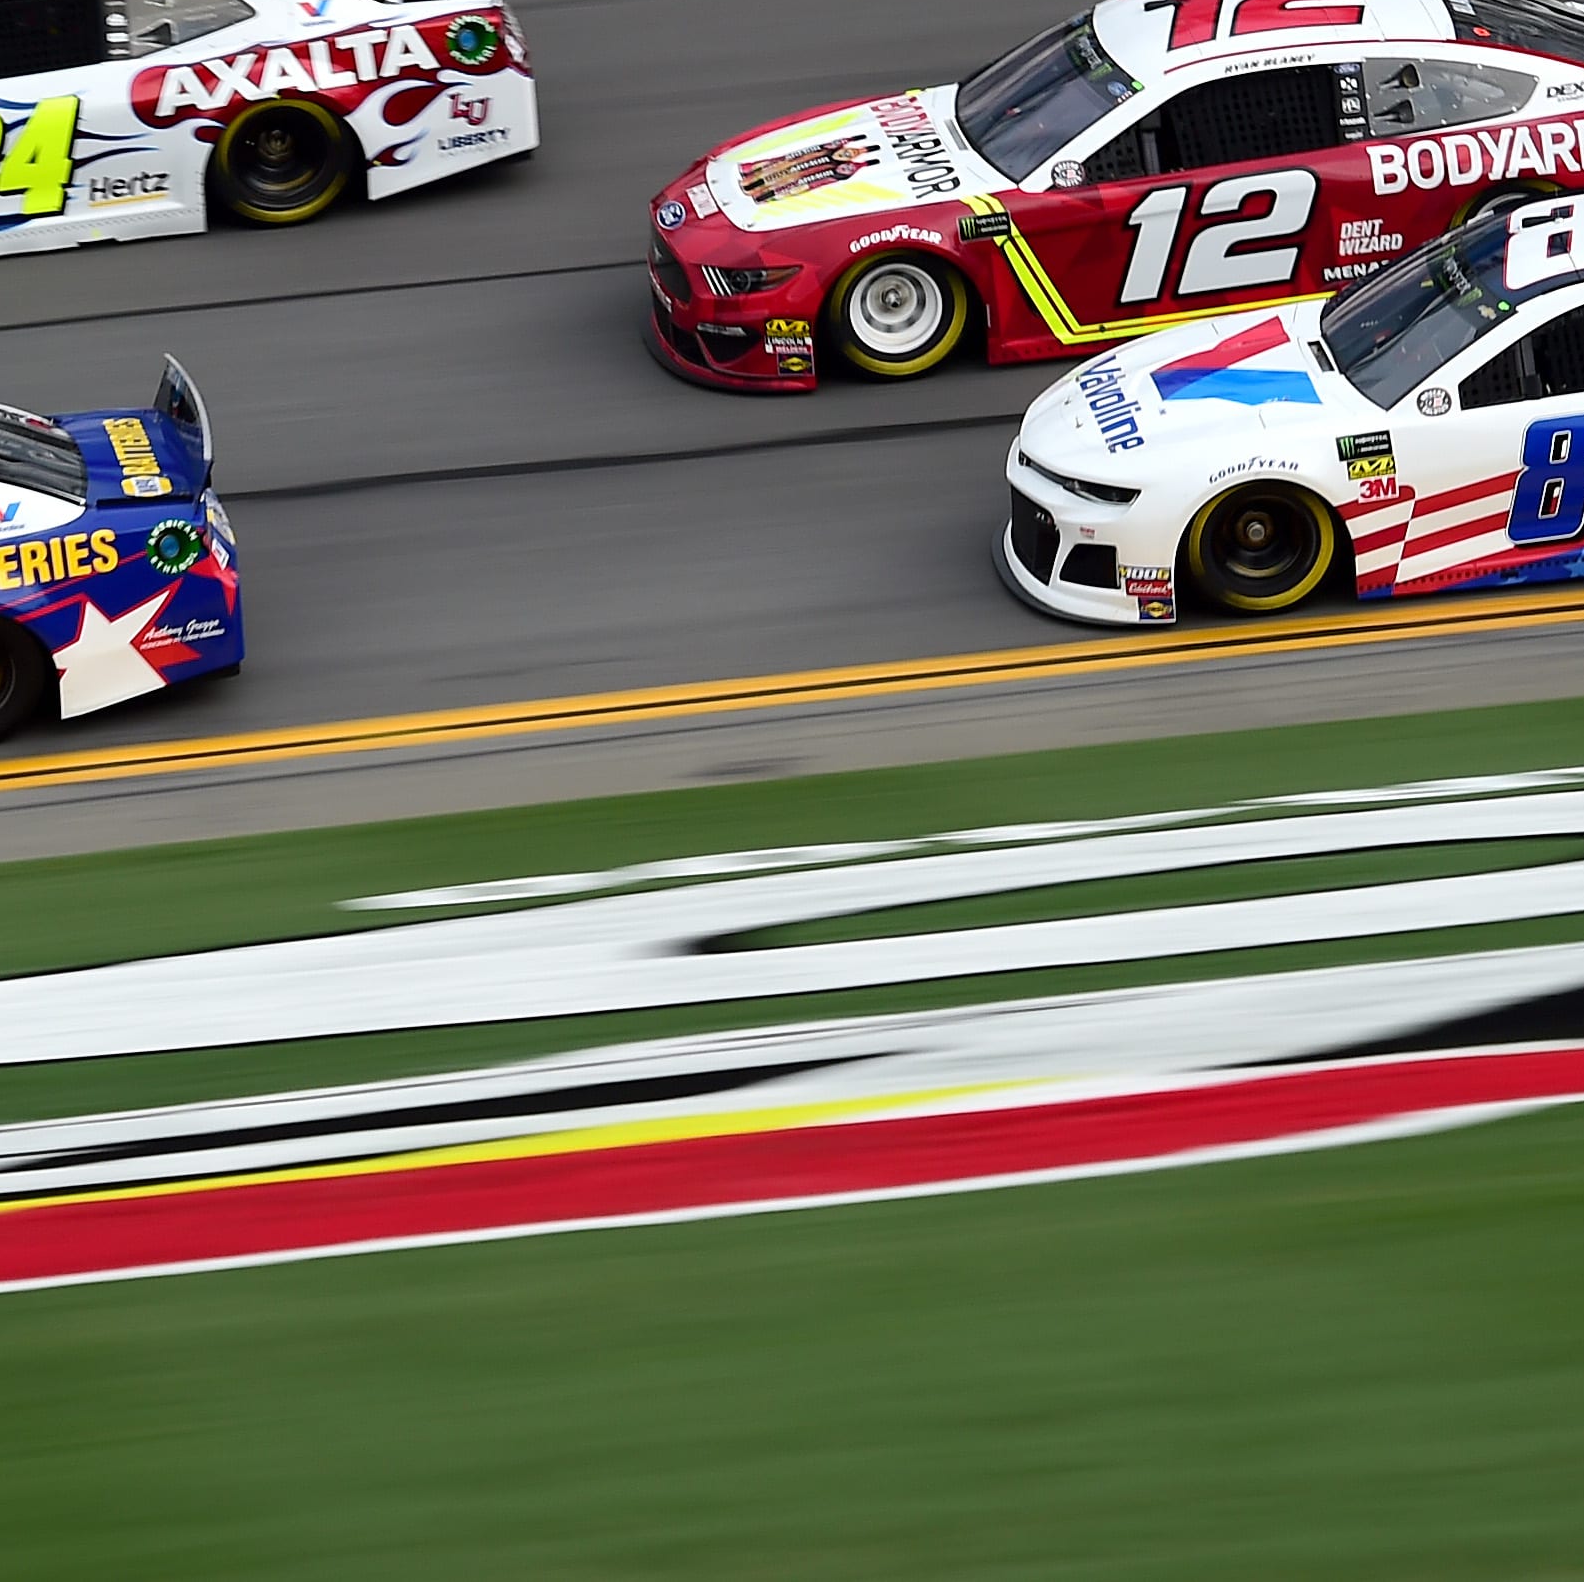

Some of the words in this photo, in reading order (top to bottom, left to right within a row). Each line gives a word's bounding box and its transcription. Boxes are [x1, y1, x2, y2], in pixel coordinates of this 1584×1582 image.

[155, 25, 440, 117] AXALTA
[1225, 61, 1259, 74] RYAN
[1263, 53, 1315, 67] BLANEY
[1547, 81, 1584, 99] DEX
[438, 128, 510, 150] LIBERTY
[88, 170, 169, 203] Hertz
[850, 225, 943, 254] GOODYEAR
[1121, 169, 1317, 304] 12
[1341, 219, 1383, 239] DENT
[1339, 234, 1403, 256] WIZARD
[1078, 354, 1145, 454] Valvoline
[1209, 456, 1299, 484] GOODYEAR
[1360, 477, 1397, 499] 3M
